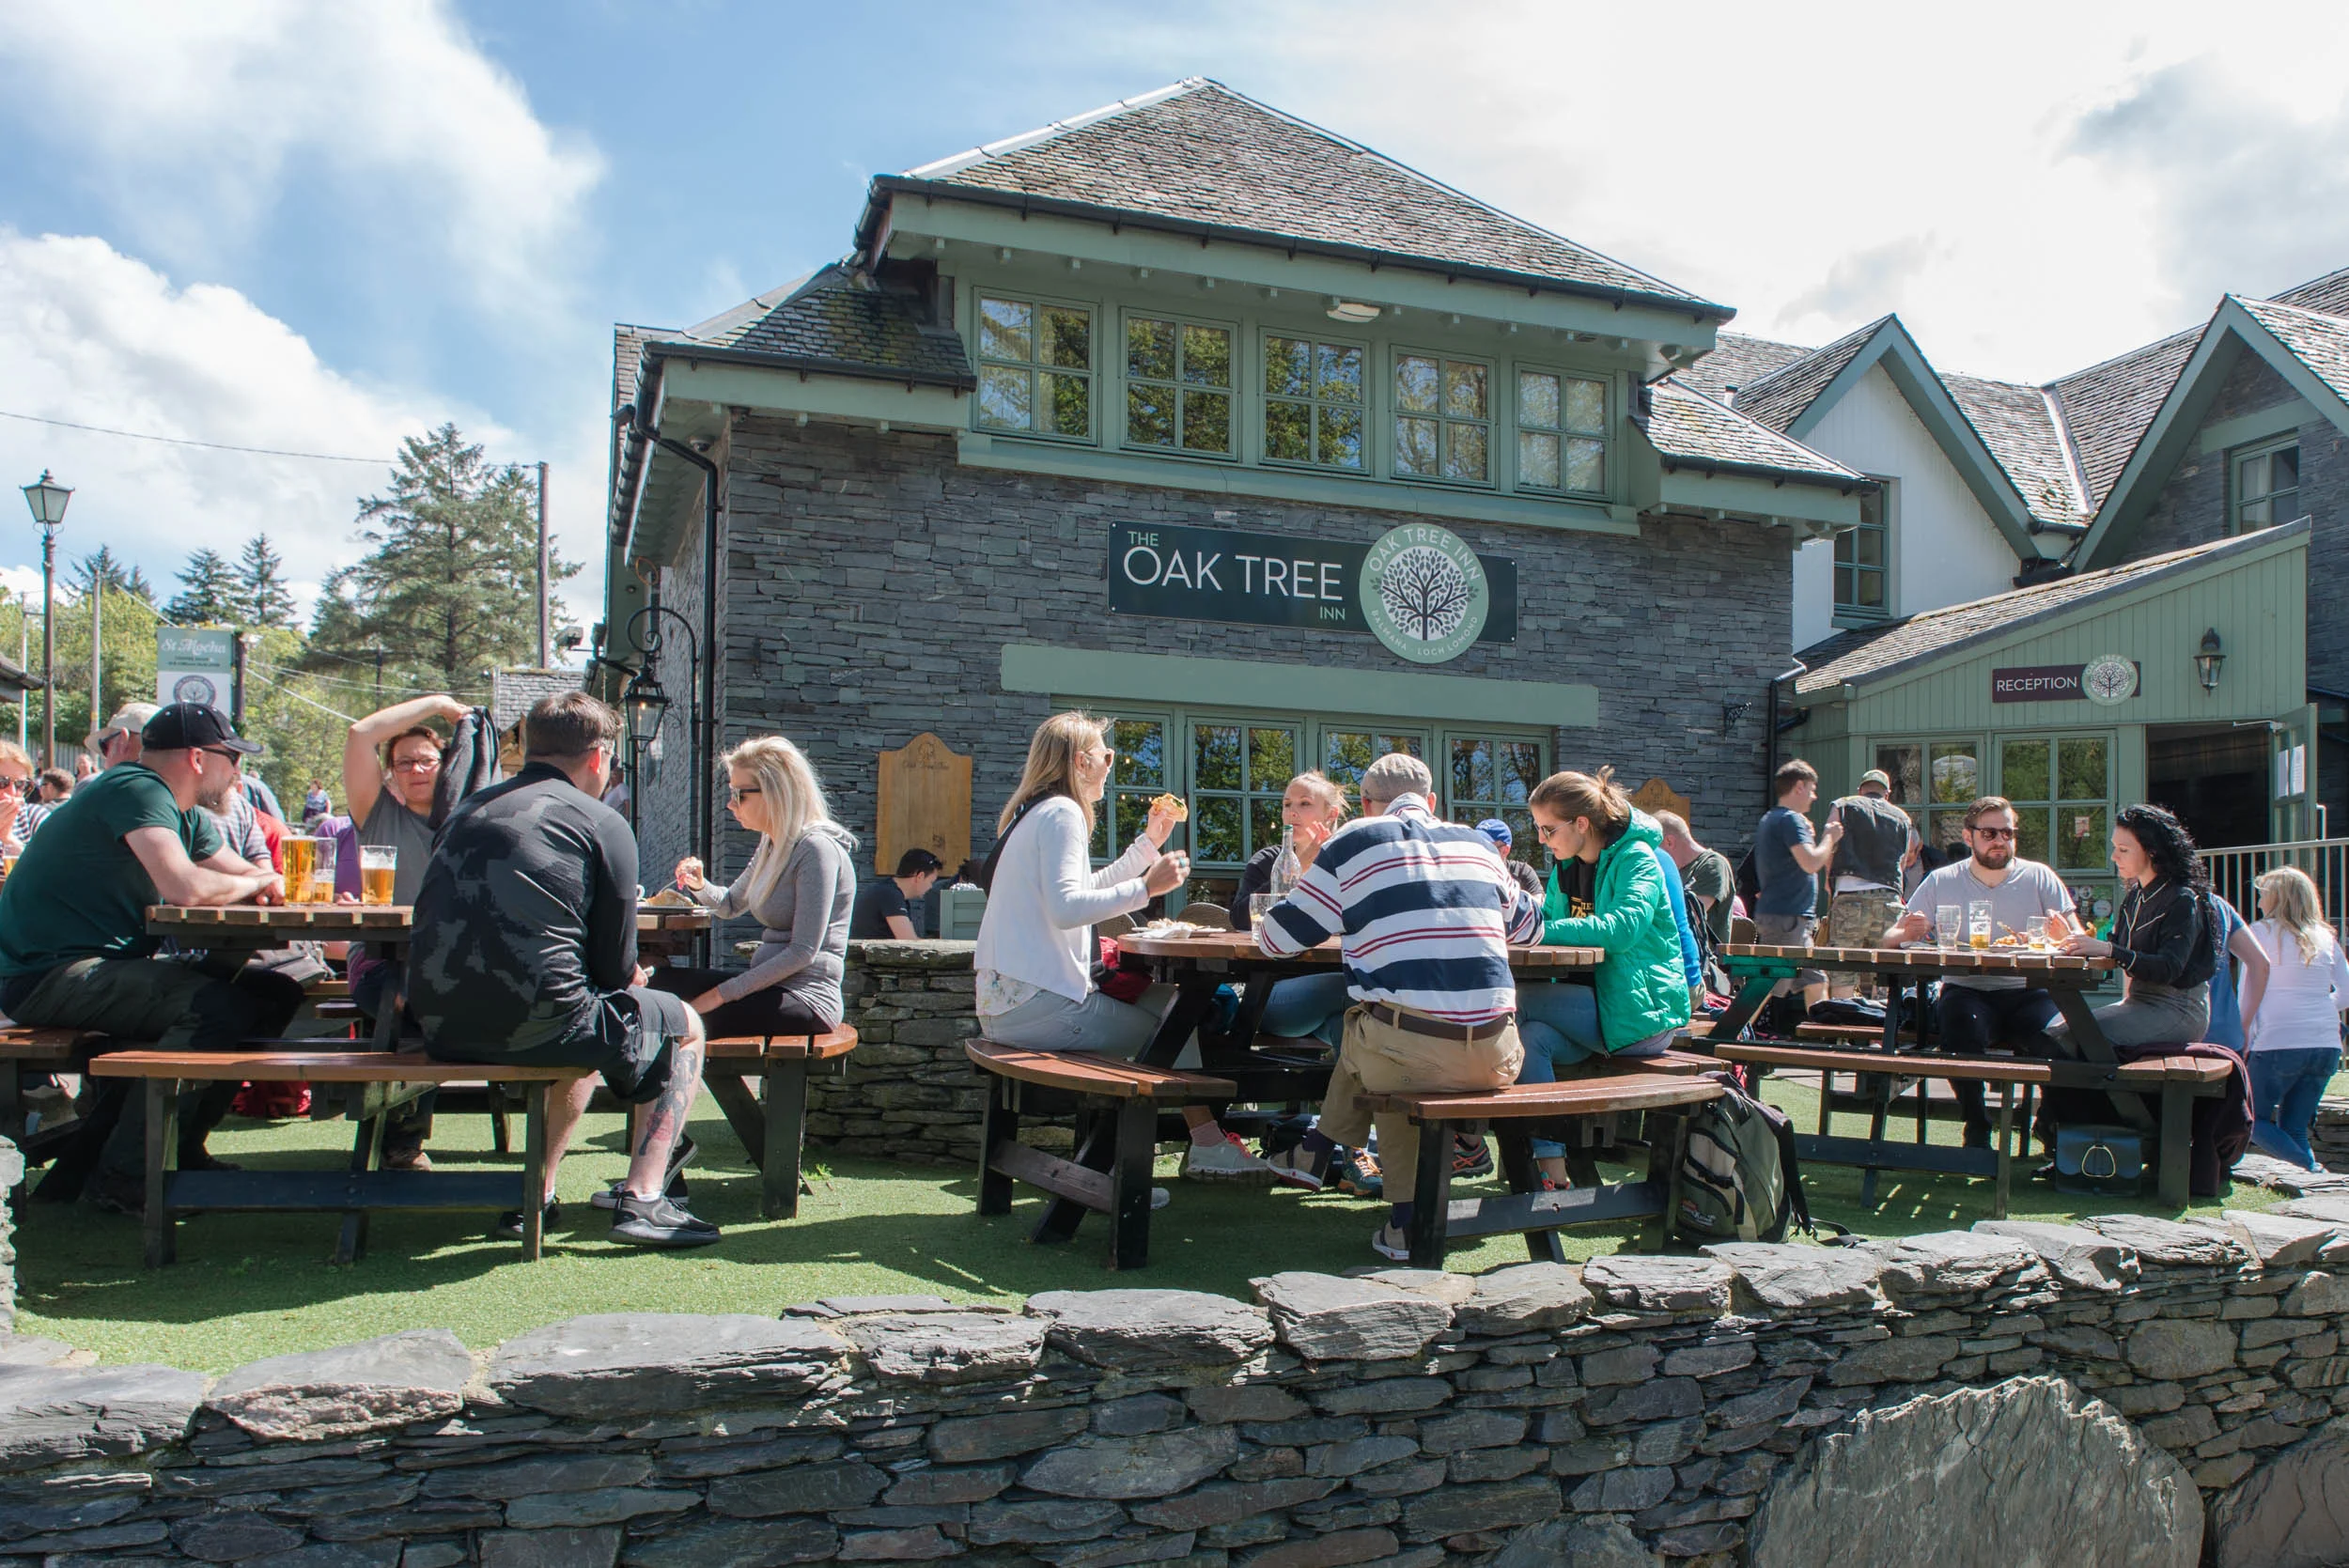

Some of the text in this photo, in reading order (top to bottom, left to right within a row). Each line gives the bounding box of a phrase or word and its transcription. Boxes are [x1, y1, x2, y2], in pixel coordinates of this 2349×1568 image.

[1128, 531, 1159, 547] THE
[1369, 527, 1482, 581] OAK TREE INN
[1123, 546, 1344, 601] OAK TREE
[1319, 606, 1346, 621] INN
[1372, 609, 1478, 656] BALMAHA LOCH LOMOND
[1997, 675, 2077, 692] RECEPTION
